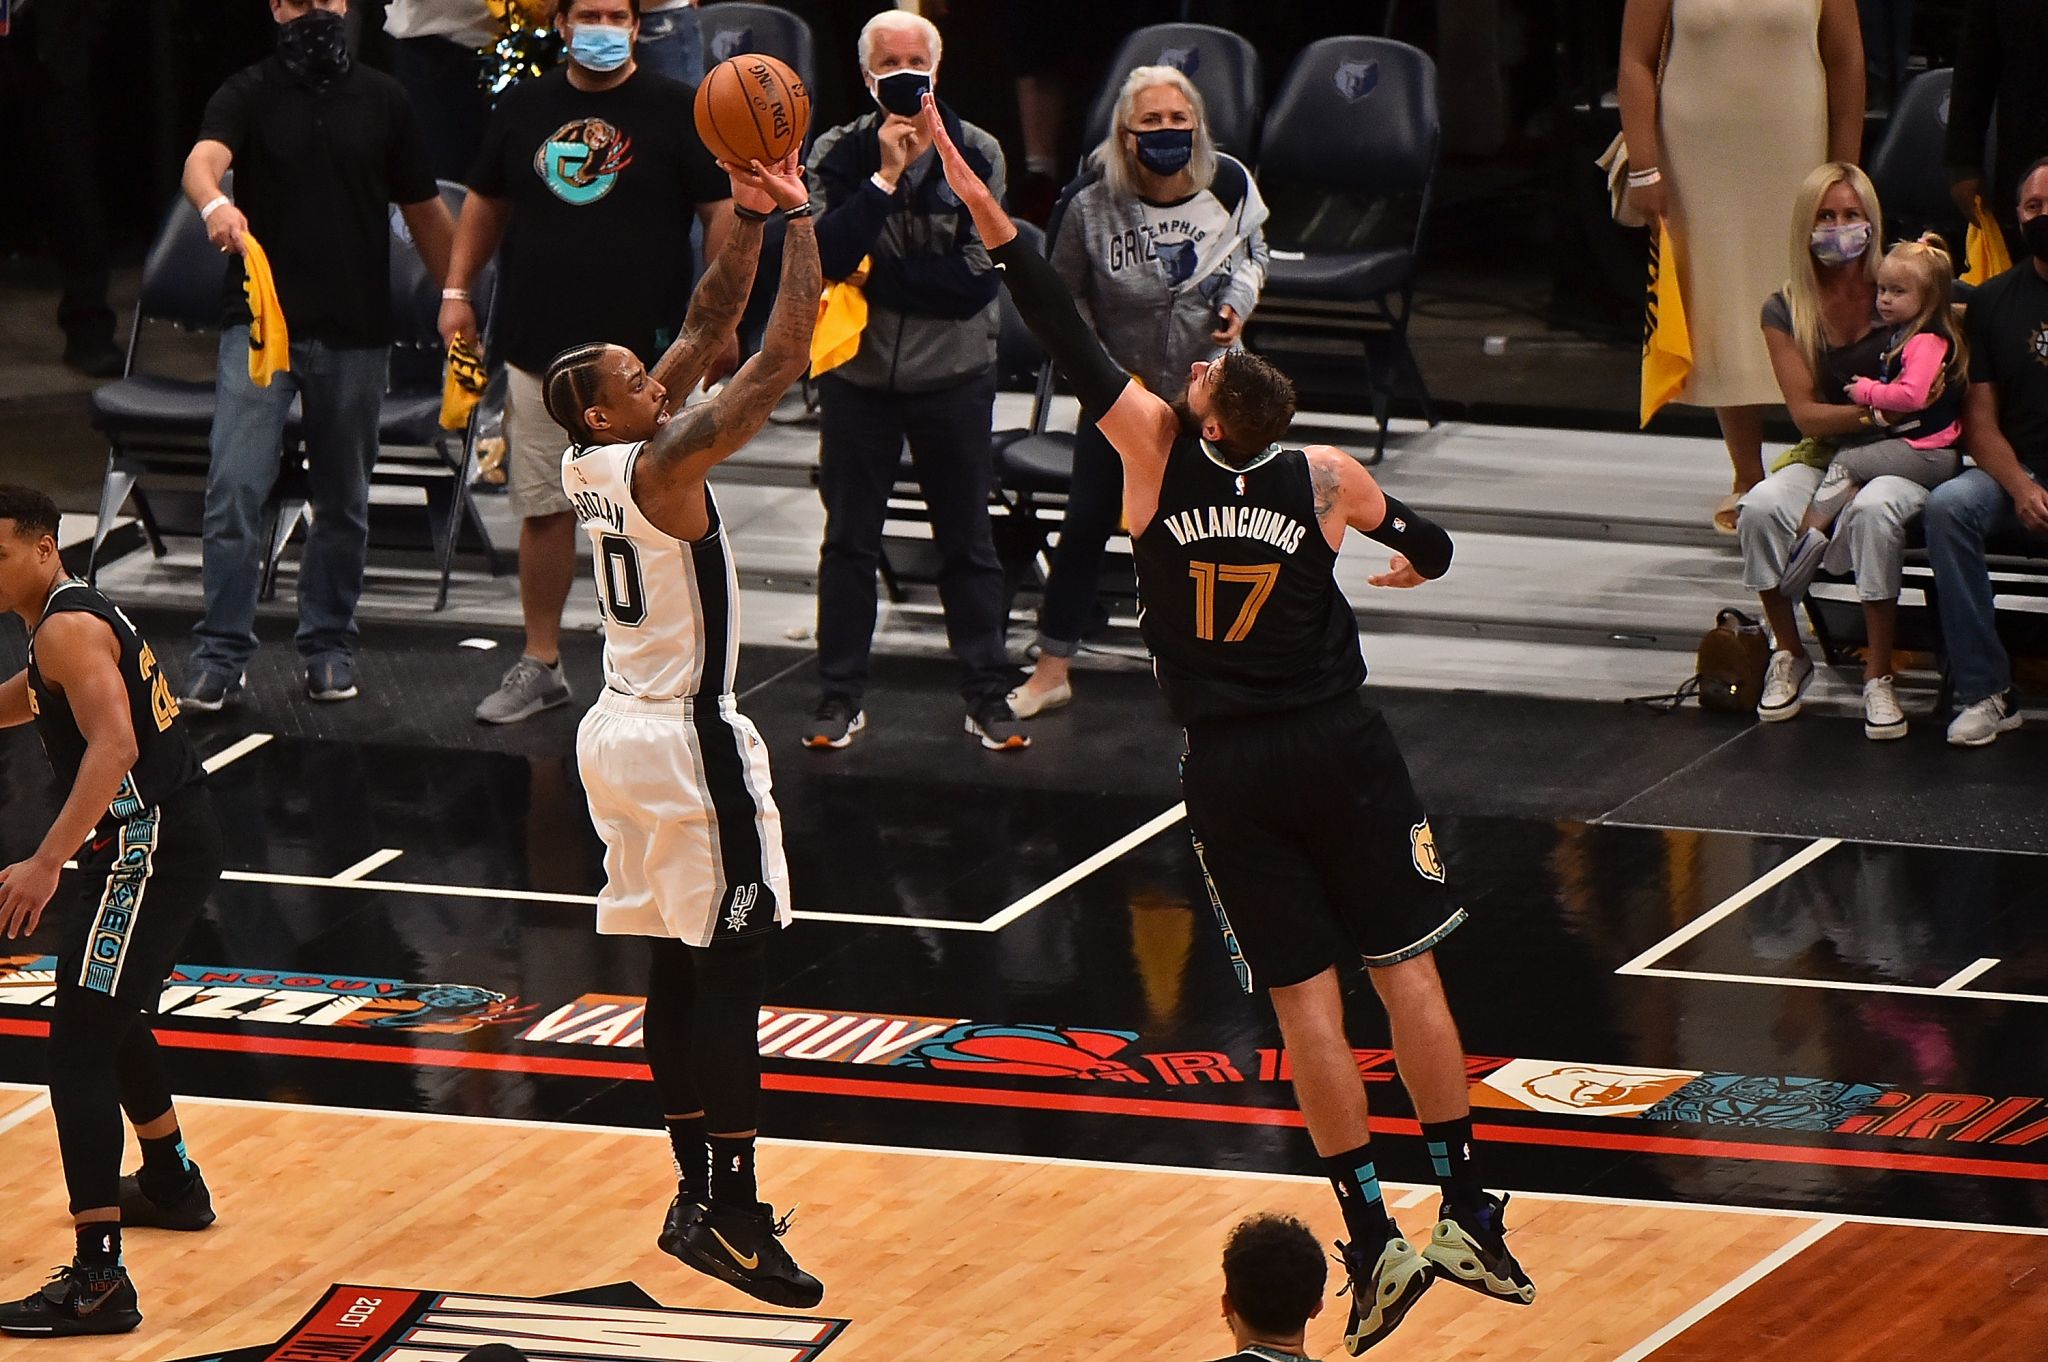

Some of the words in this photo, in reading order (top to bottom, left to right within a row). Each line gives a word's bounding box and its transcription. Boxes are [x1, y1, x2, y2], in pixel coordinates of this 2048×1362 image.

[748, 63, 791, 139] SPALING
[1150, 220, 1205, 241] EMPHIS
[1163, 505, 1306, 555] VALANCIUNAS
[1188, 559, 1281, 642] 17
[335, 1296, 382, 1328] 2001
